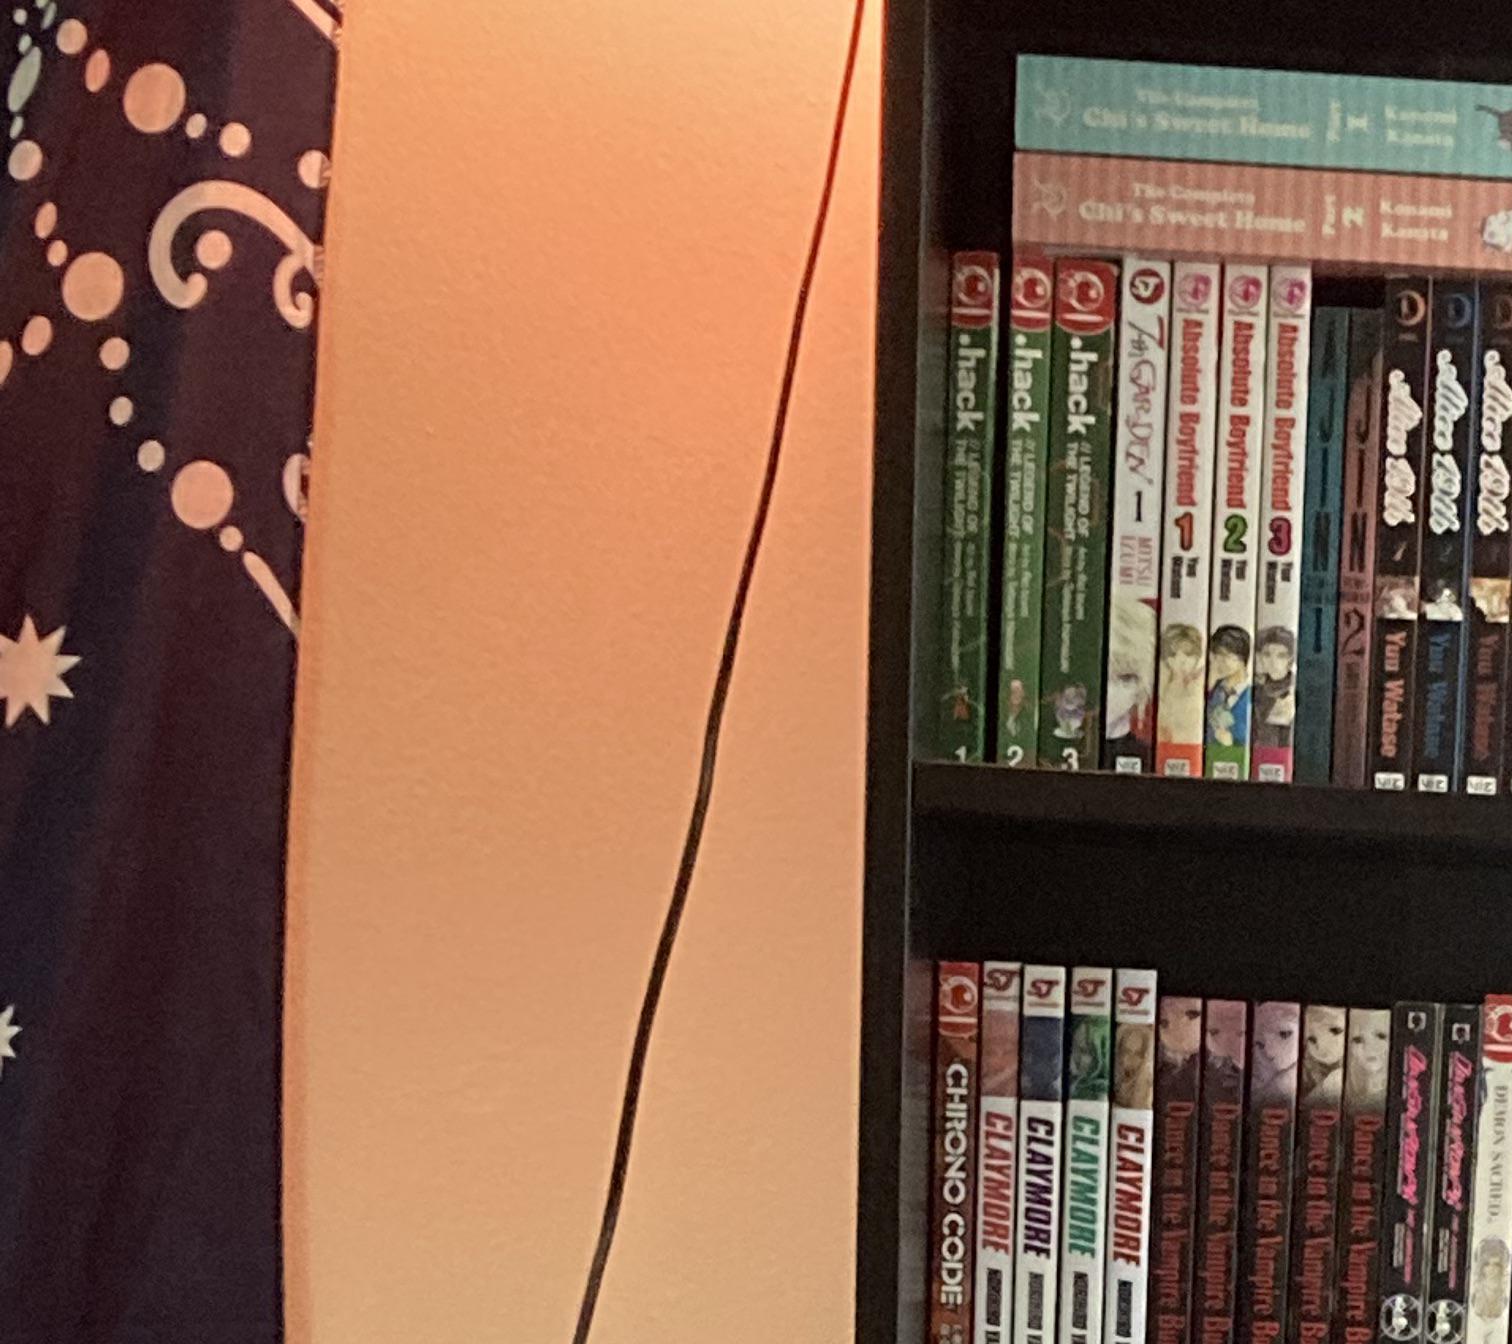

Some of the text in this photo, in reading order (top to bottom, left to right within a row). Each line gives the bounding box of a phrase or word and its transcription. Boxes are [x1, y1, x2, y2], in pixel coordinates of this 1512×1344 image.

[1079, 200, 1307, 233] Chi's Sweet Home
[955, 334, 986, 432] .hack
[1012, 334, 1043, 433] .hack
[1067, 336, 1099, 435] .hack
[1175, 319, 1204, 551] Absolute Boyfriend 1
[1225, 320, 1254, 510] Absolute Boyfriend
[1270, 322, 1299, 512] Absolute Boyfriend
[941, 1062, 968, 1306] CHRONO CODE
[982, 1112, 1013, 1256] CLAYMORE
[1023, 1116, 1055, 1260] CLAYMORE
[1069, 1115, 1101, 1259] CLAYMORE
[1113, 1122, 1145, 1268] CLAYMORE
